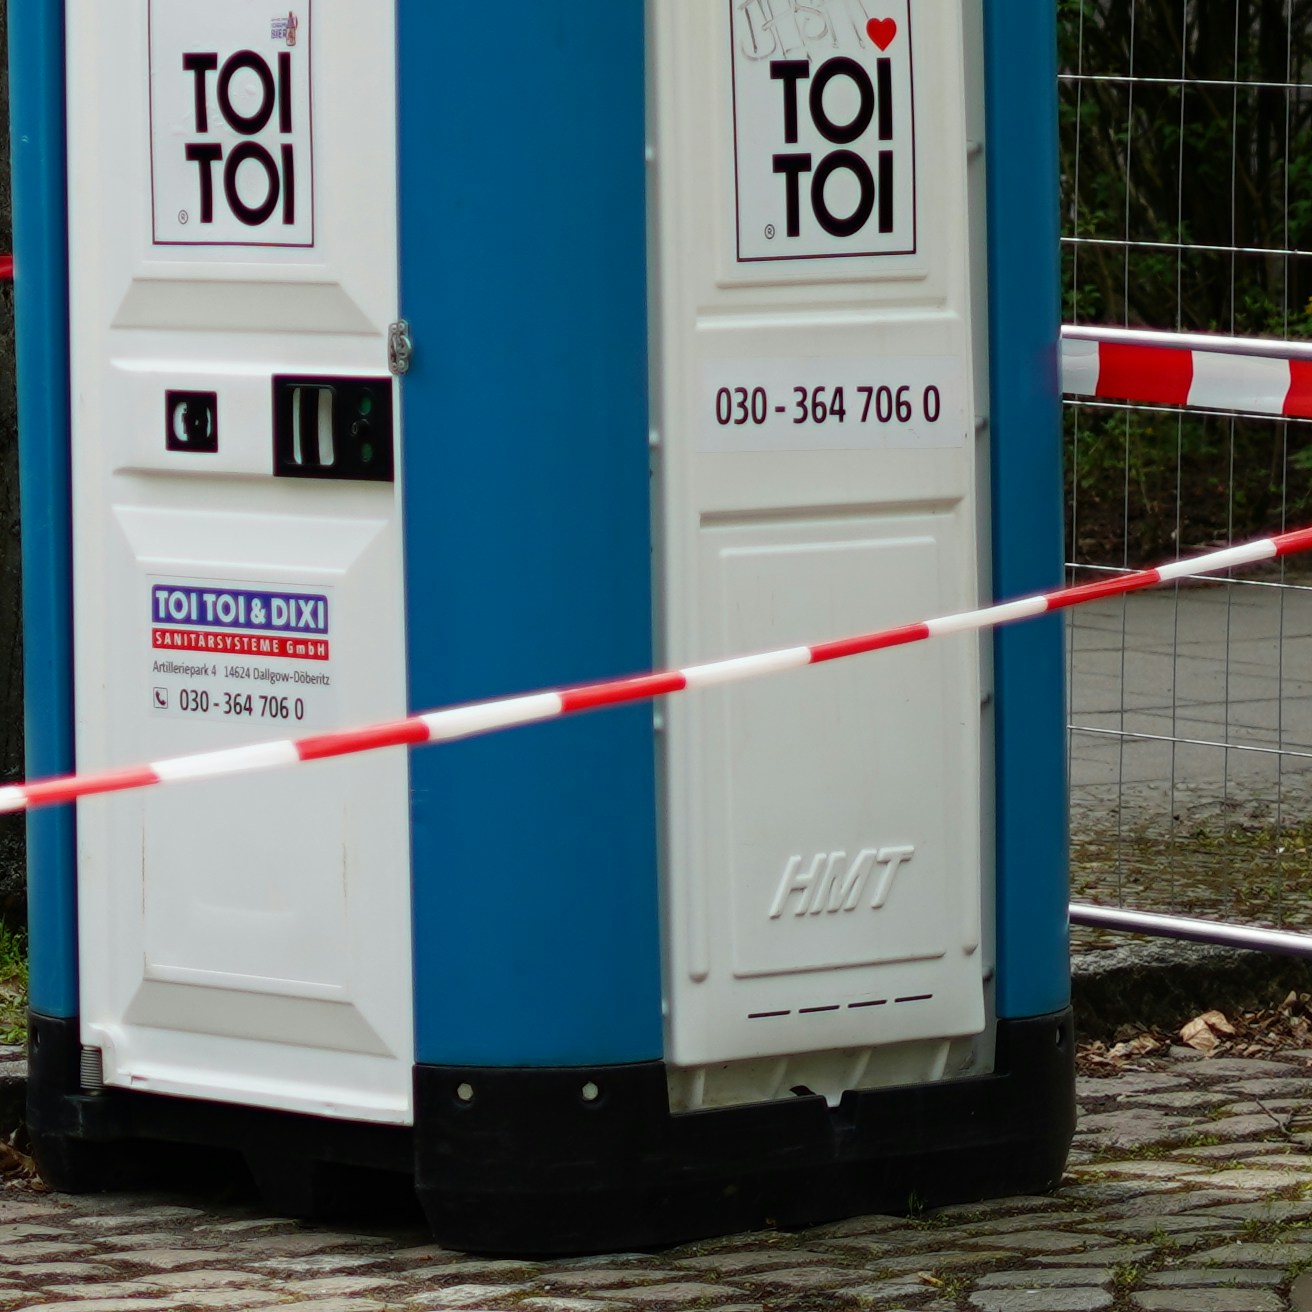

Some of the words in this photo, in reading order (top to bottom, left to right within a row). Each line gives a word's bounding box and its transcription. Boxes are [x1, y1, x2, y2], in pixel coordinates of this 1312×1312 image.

[182, 49, 292, 136] TOI
[769, 56, 893, 144] TOI
[184, 140, 295, 226] TOI
[772, 149, 893, 237] TOI
[715, 386, 767, 425] 030
[793, 386, 846, 424] 364
[856, 385, 912, 423] 706
[922, 385, 940, 423] 0
[155, 590, 197, 621] TOI
[203, 593, 245, 624] TOI
[250, 598, 266, 624] &
[271, 598, 324, 629] DIXI
[155, 631, 279, 653] SANITÄRSYSTEME
[286, 641, 325, 656] GmbH
[152, 660, 209, 678] Artilleriepark
[211, 664, 217, 677] 4
[224, 665, 251, 679] 14624
[253, 667, 330, 686] Dallgow-Döberitz
[179, 688, 209, 713] 030
[223, 692, 253, 716] 364
[259, 694, 289, 719] 706
[294, 697, 304, 720] 0
[769, 844, 915, 920] HMT
